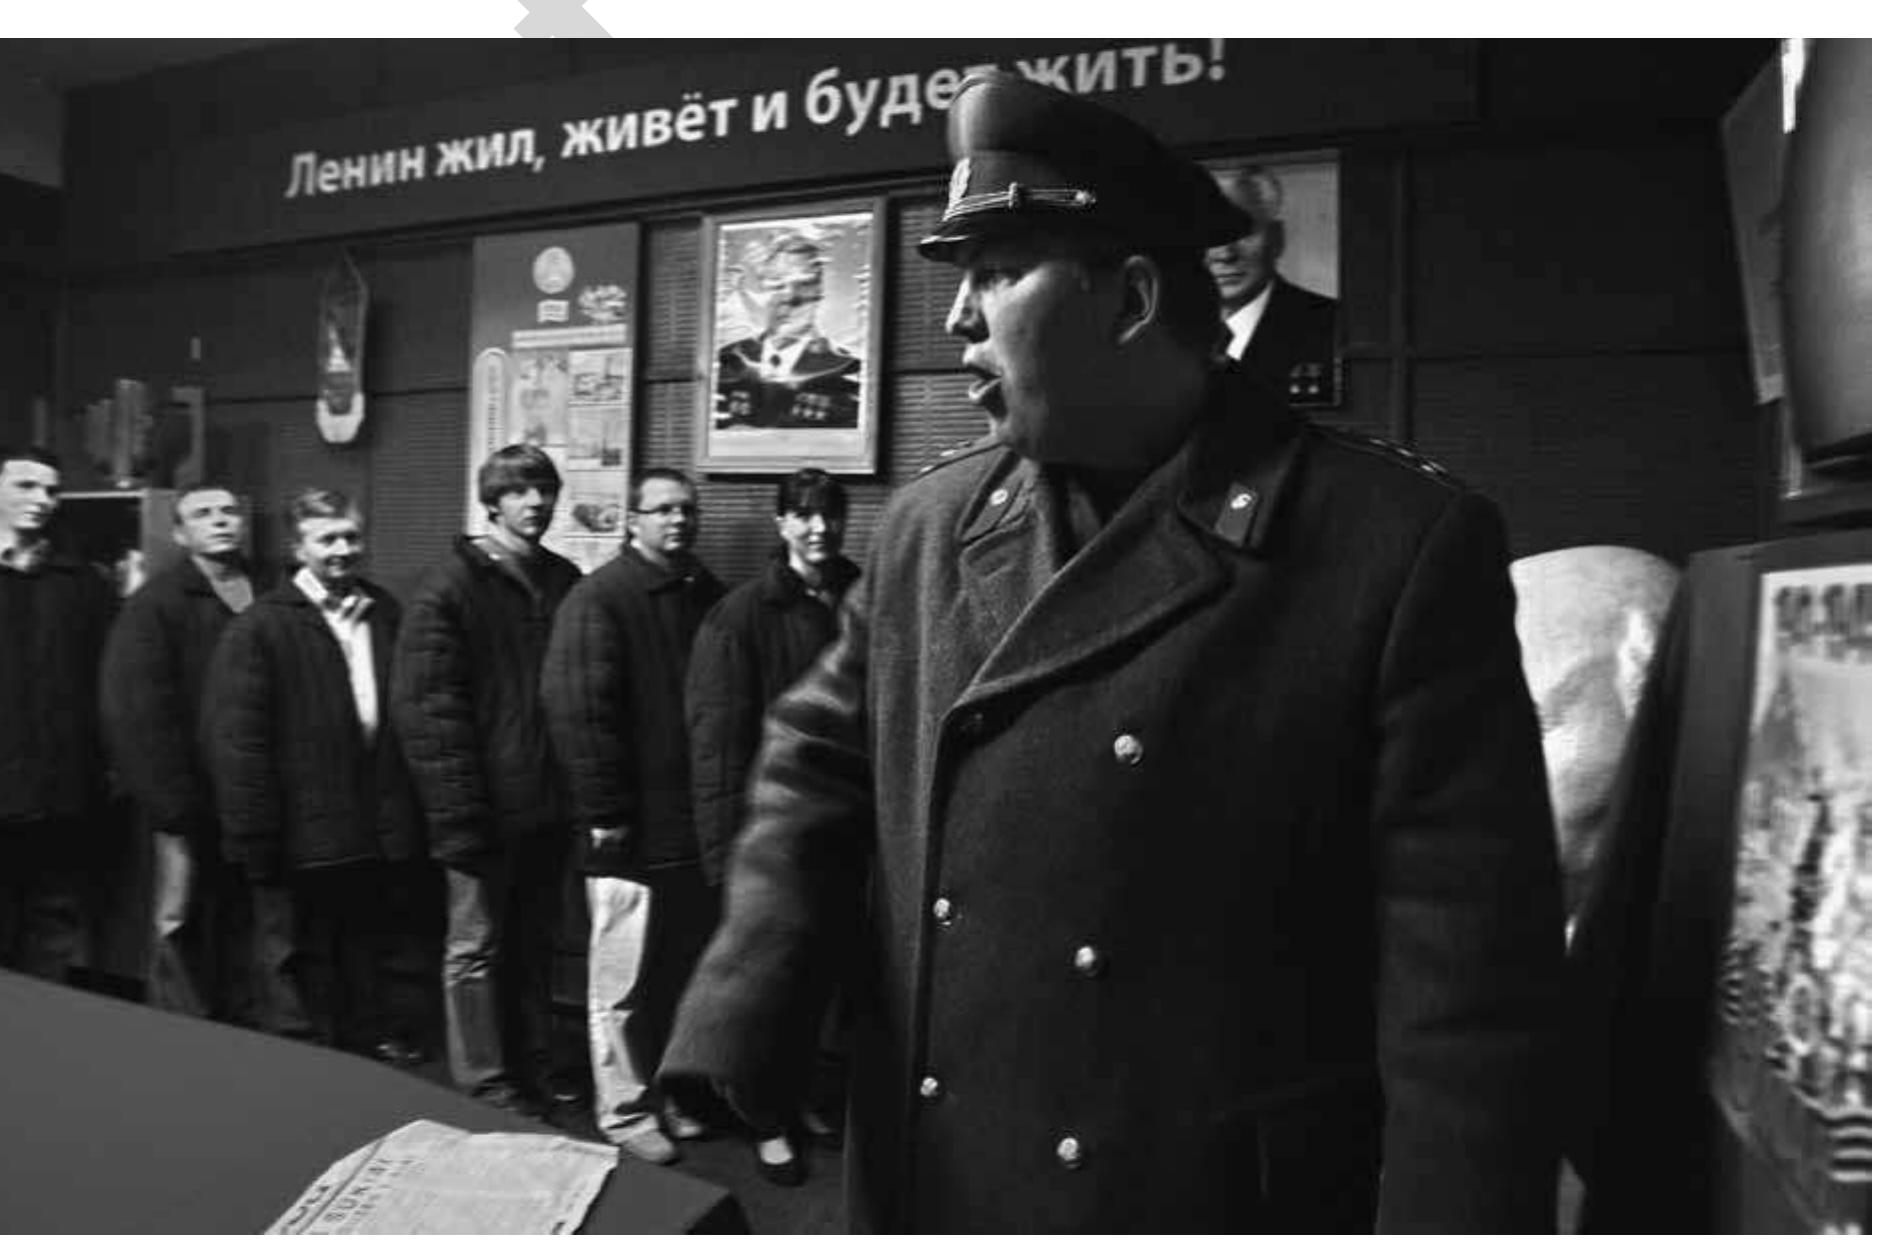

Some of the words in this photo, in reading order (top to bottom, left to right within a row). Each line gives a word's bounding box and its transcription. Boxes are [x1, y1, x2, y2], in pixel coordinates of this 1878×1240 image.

[285, 146, 425, 198] Ленин
[434, 128, 546, 172] жил,
[560, 92, 740, 158] живёт
[750, 90, 789, 133] и
